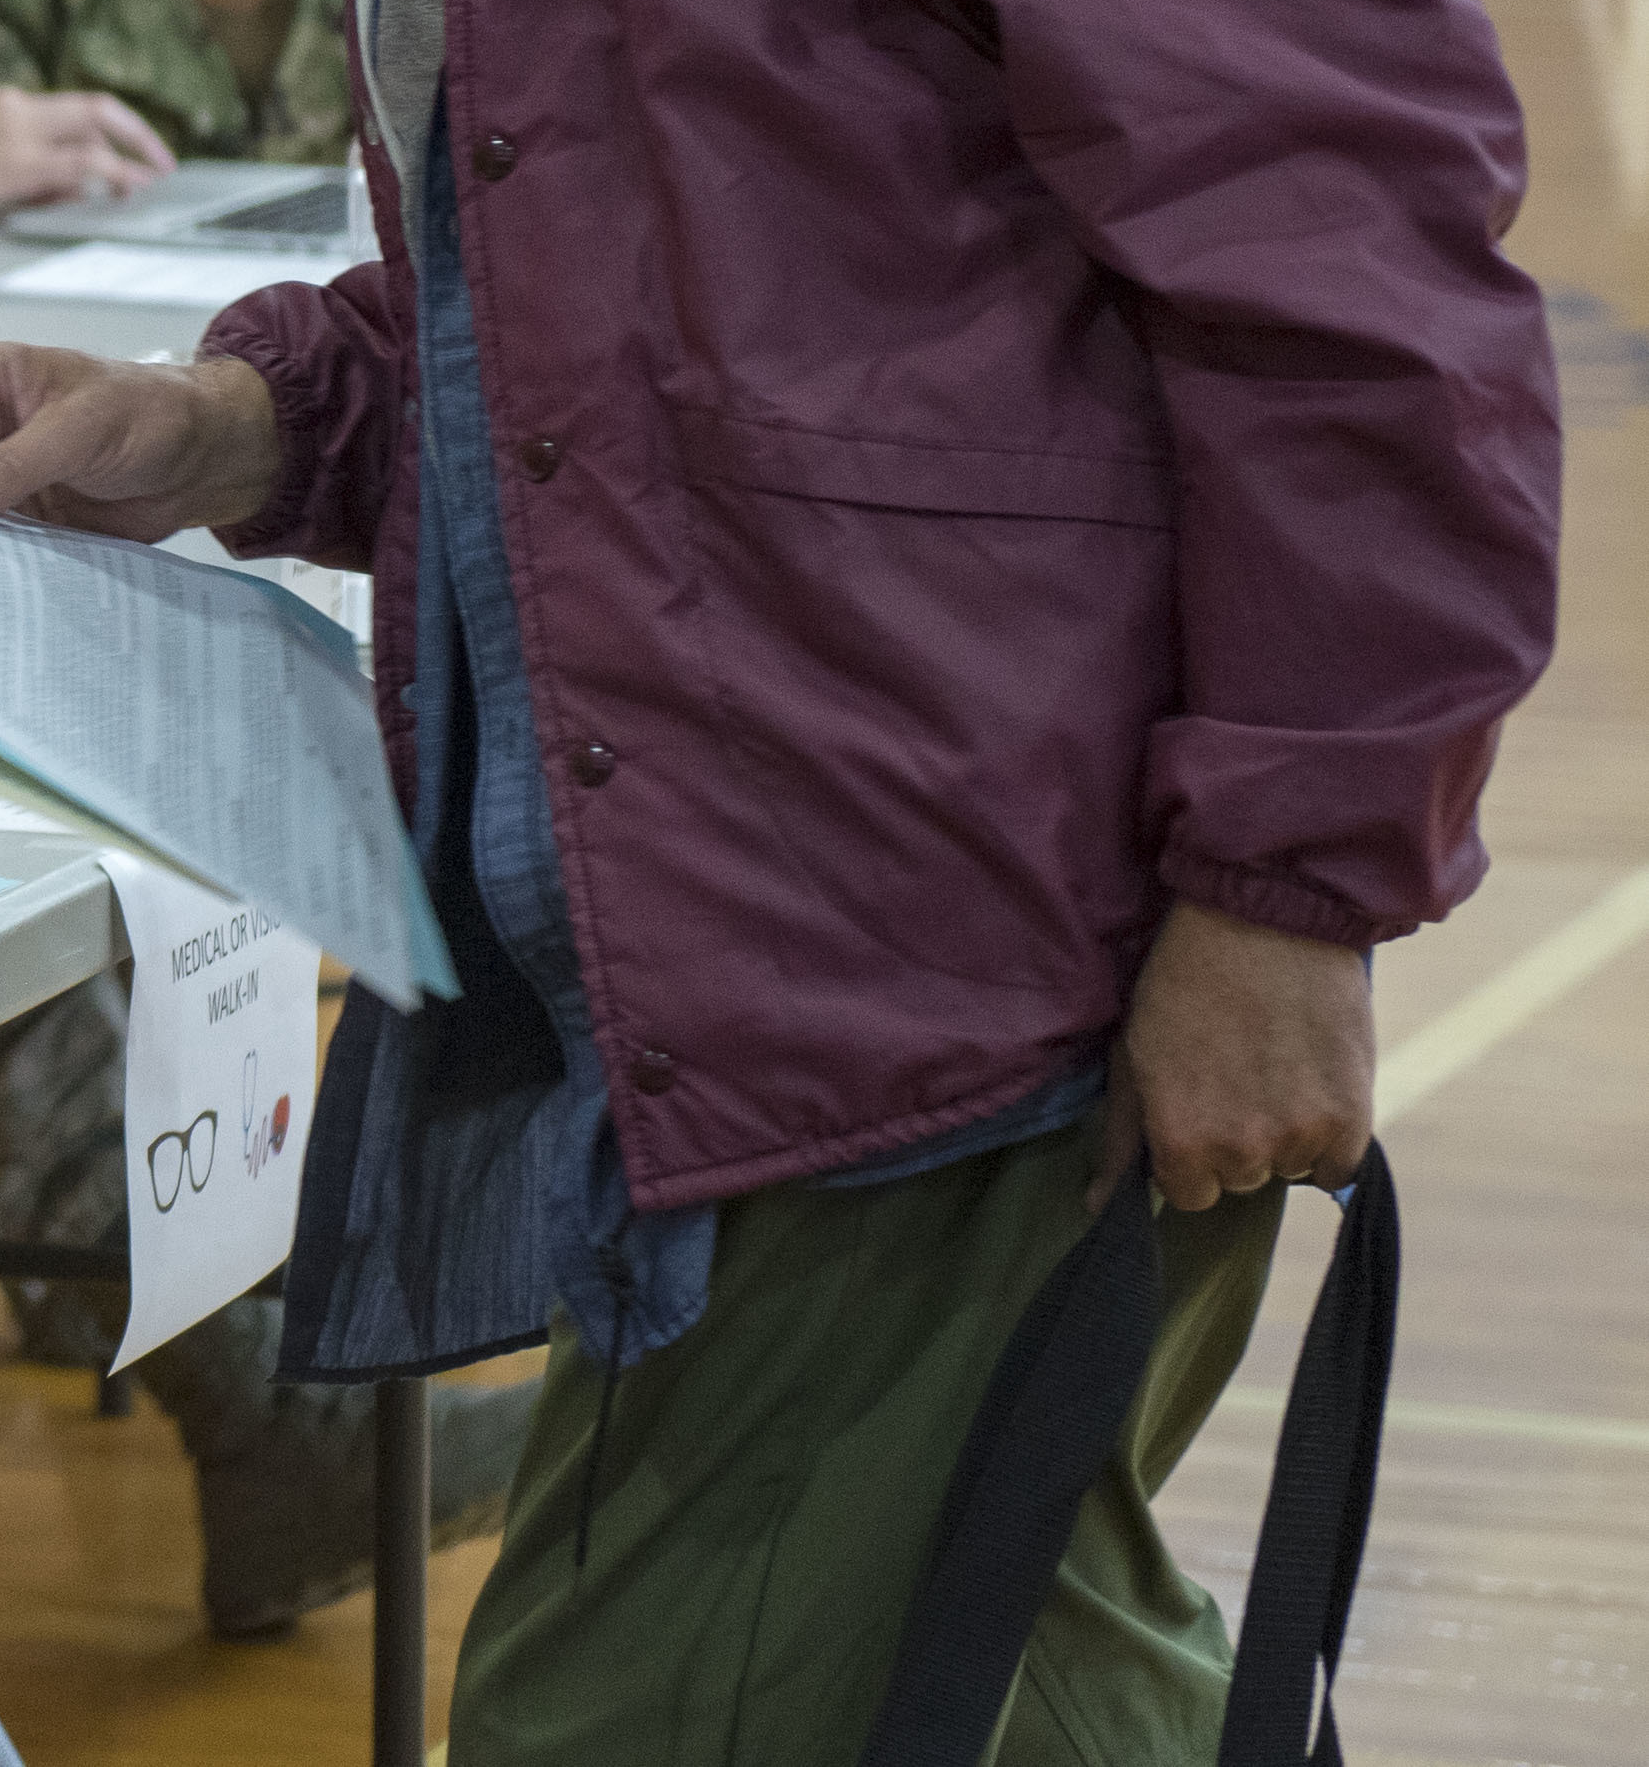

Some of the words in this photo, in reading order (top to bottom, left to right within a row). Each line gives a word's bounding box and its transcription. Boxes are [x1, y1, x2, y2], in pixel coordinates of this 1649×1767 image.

[171, 923, 229, 984] MEDICAL
[230, 913, 248, 952] OR
[207, 966, 260, 1026] WALK-IN
